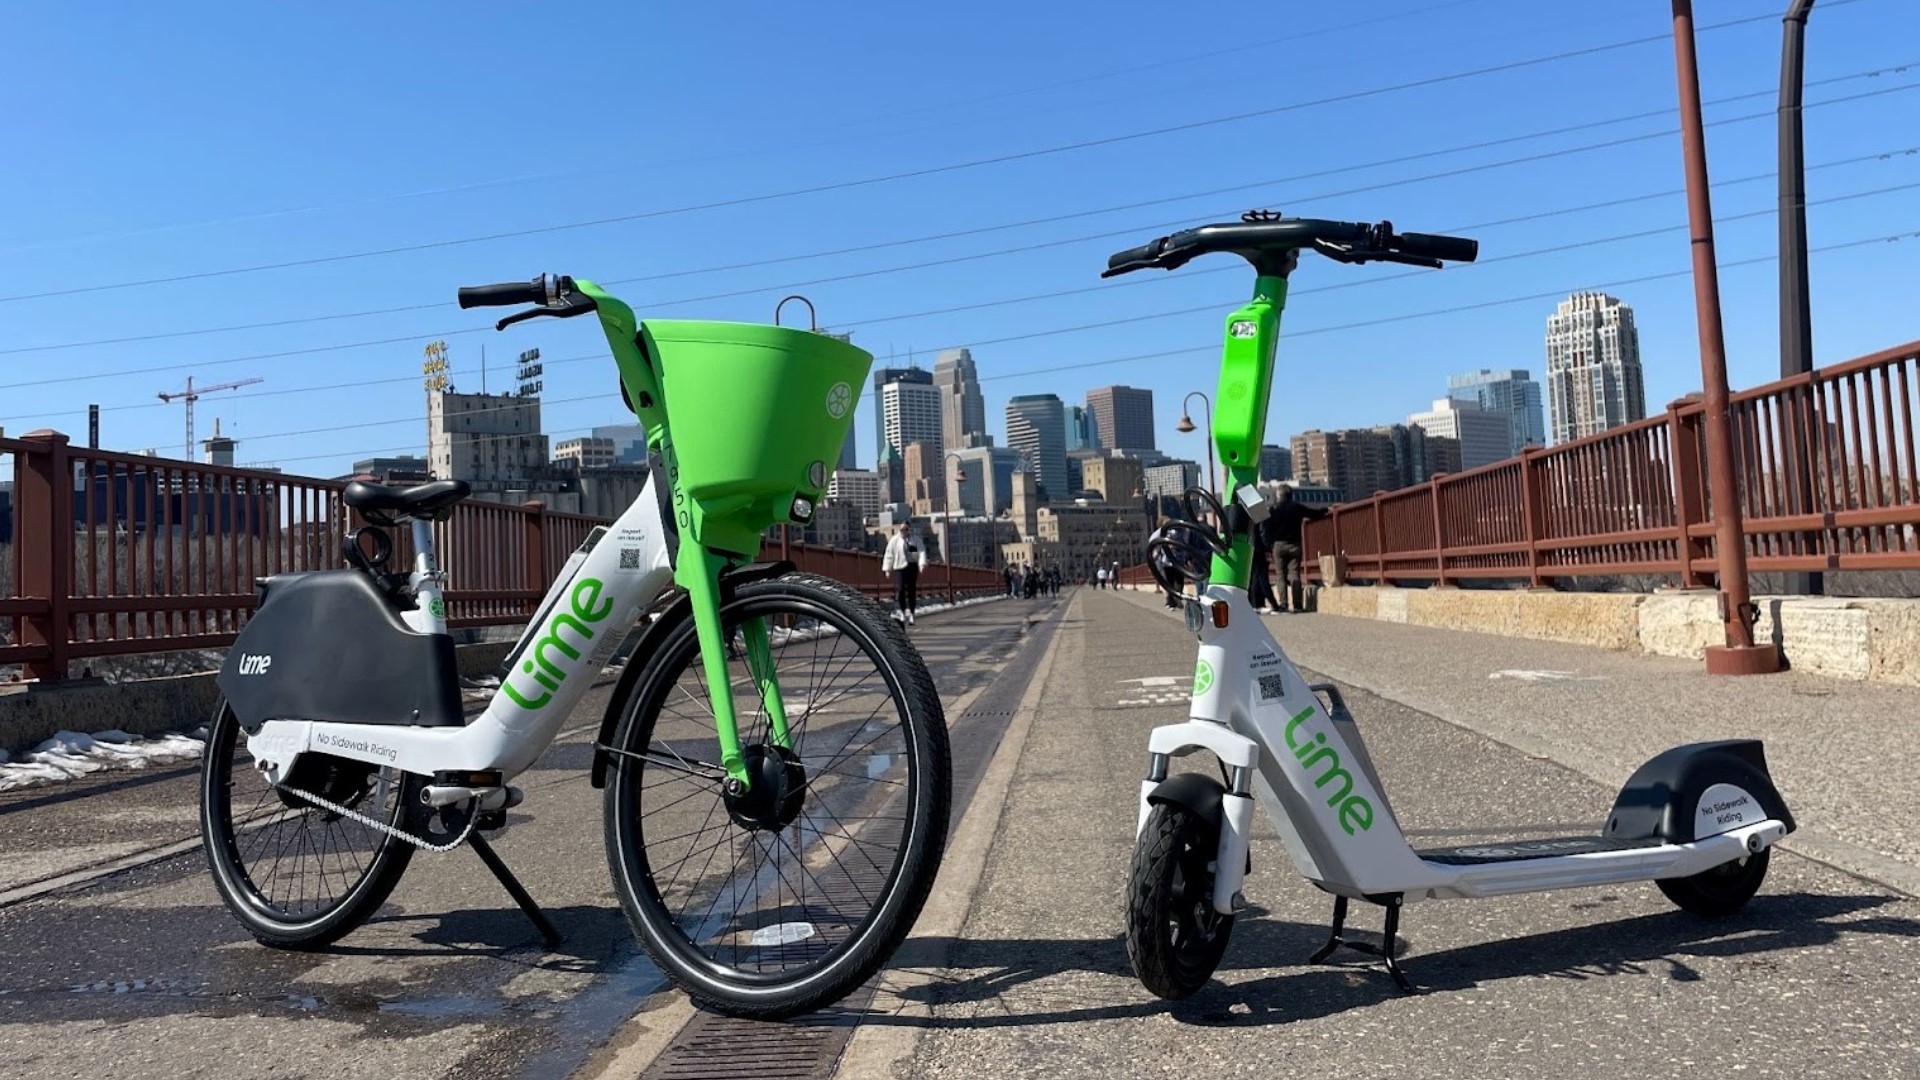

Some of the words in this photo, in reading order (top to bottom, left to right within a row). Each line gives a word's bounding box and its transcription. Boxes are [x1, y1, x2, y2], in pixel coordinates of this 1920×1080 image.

[502, 577, 614, 711] Lime
[239, 653, 271, 675] Lime
[1252, 652, 1276, 661] Report
[1261, 658, 1282, 667] issue?
[317, 732, 330, 745] No
[331, 735, 369, 752] Sidewalk
[370, 743, 397, 761] Riding
[1285, 705, 1374, 836] Lime
[1701, 806, 1713, 816] No
[1713, 796, 1748, 813] Sidewalk
[1716, 812, 1743, 825] Riding
